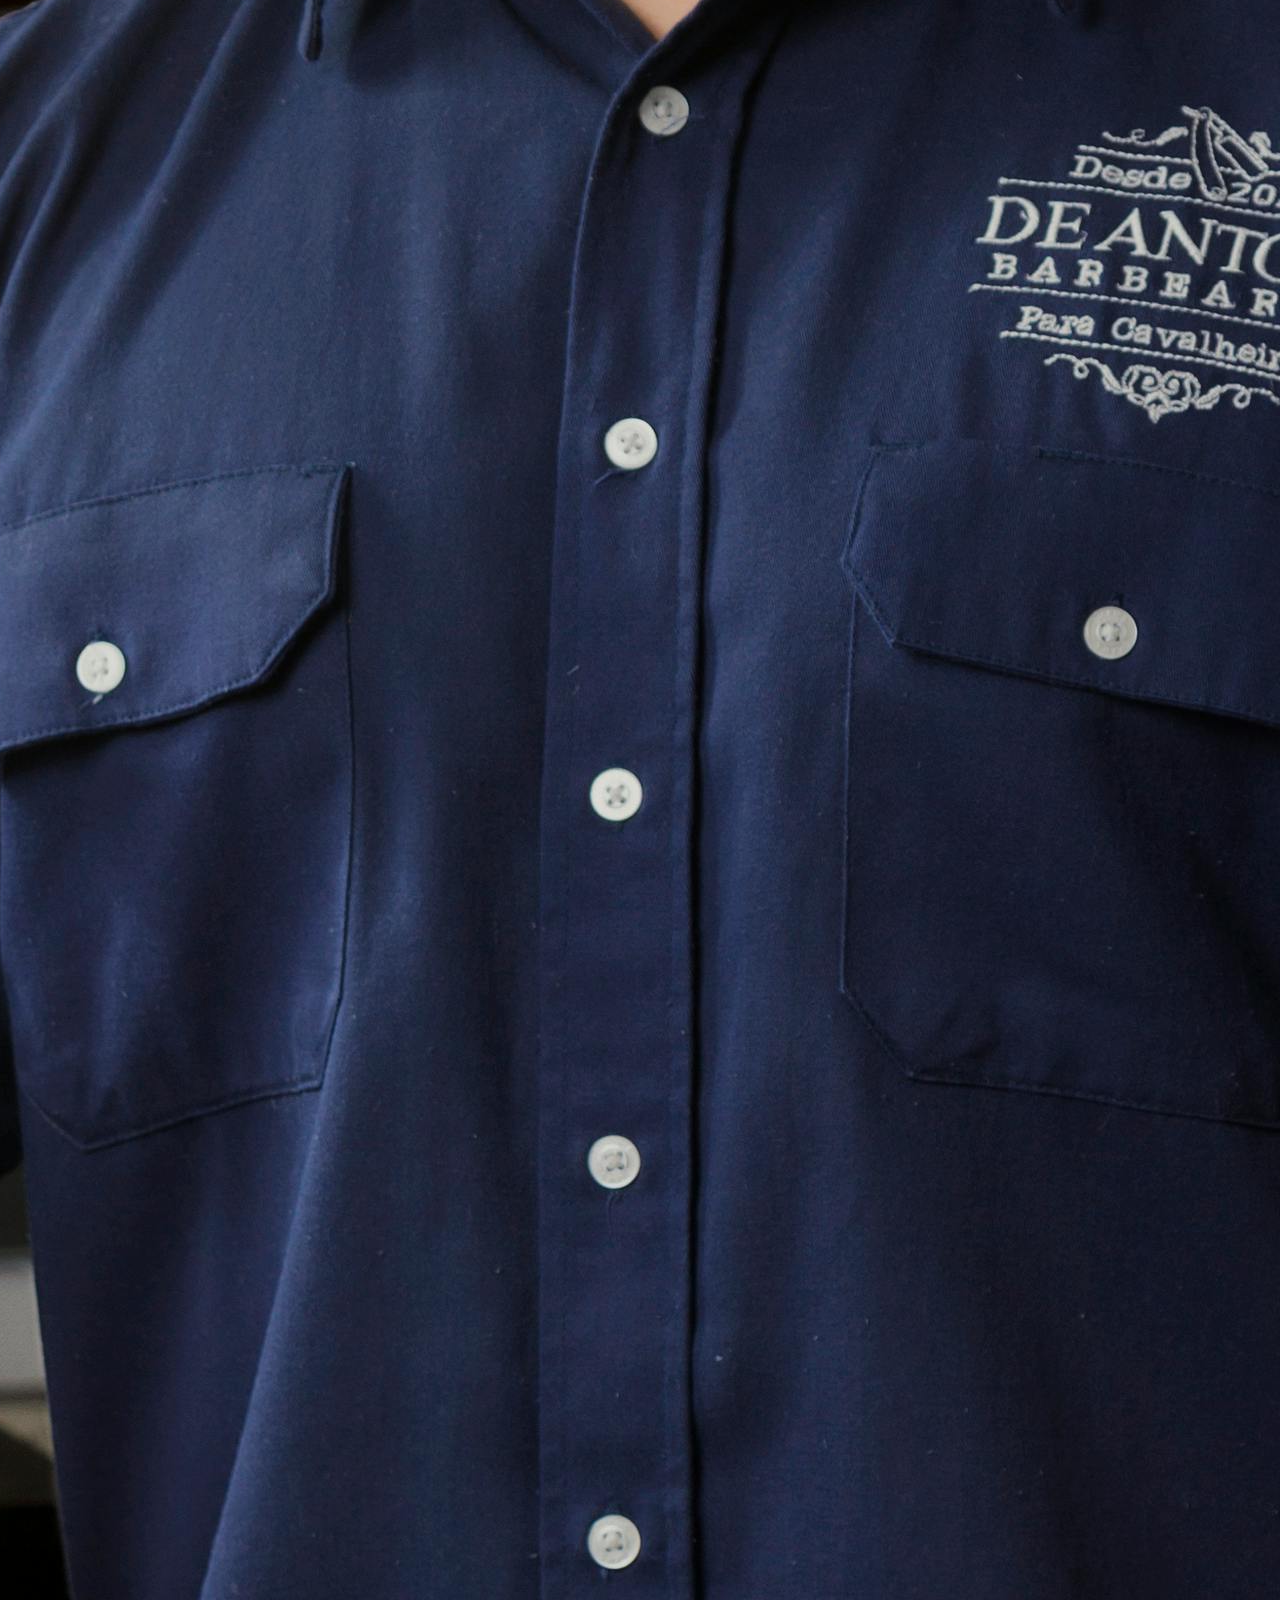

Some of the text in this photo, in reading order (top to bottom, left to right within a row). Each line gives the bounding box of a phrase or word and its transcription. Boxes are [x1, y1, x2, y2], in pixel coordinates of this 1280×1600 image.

[1068, 154, 1191, 191] Desde
[975, 194, 1093, 250] DE
[1015, 304, 1095, 338] Para
